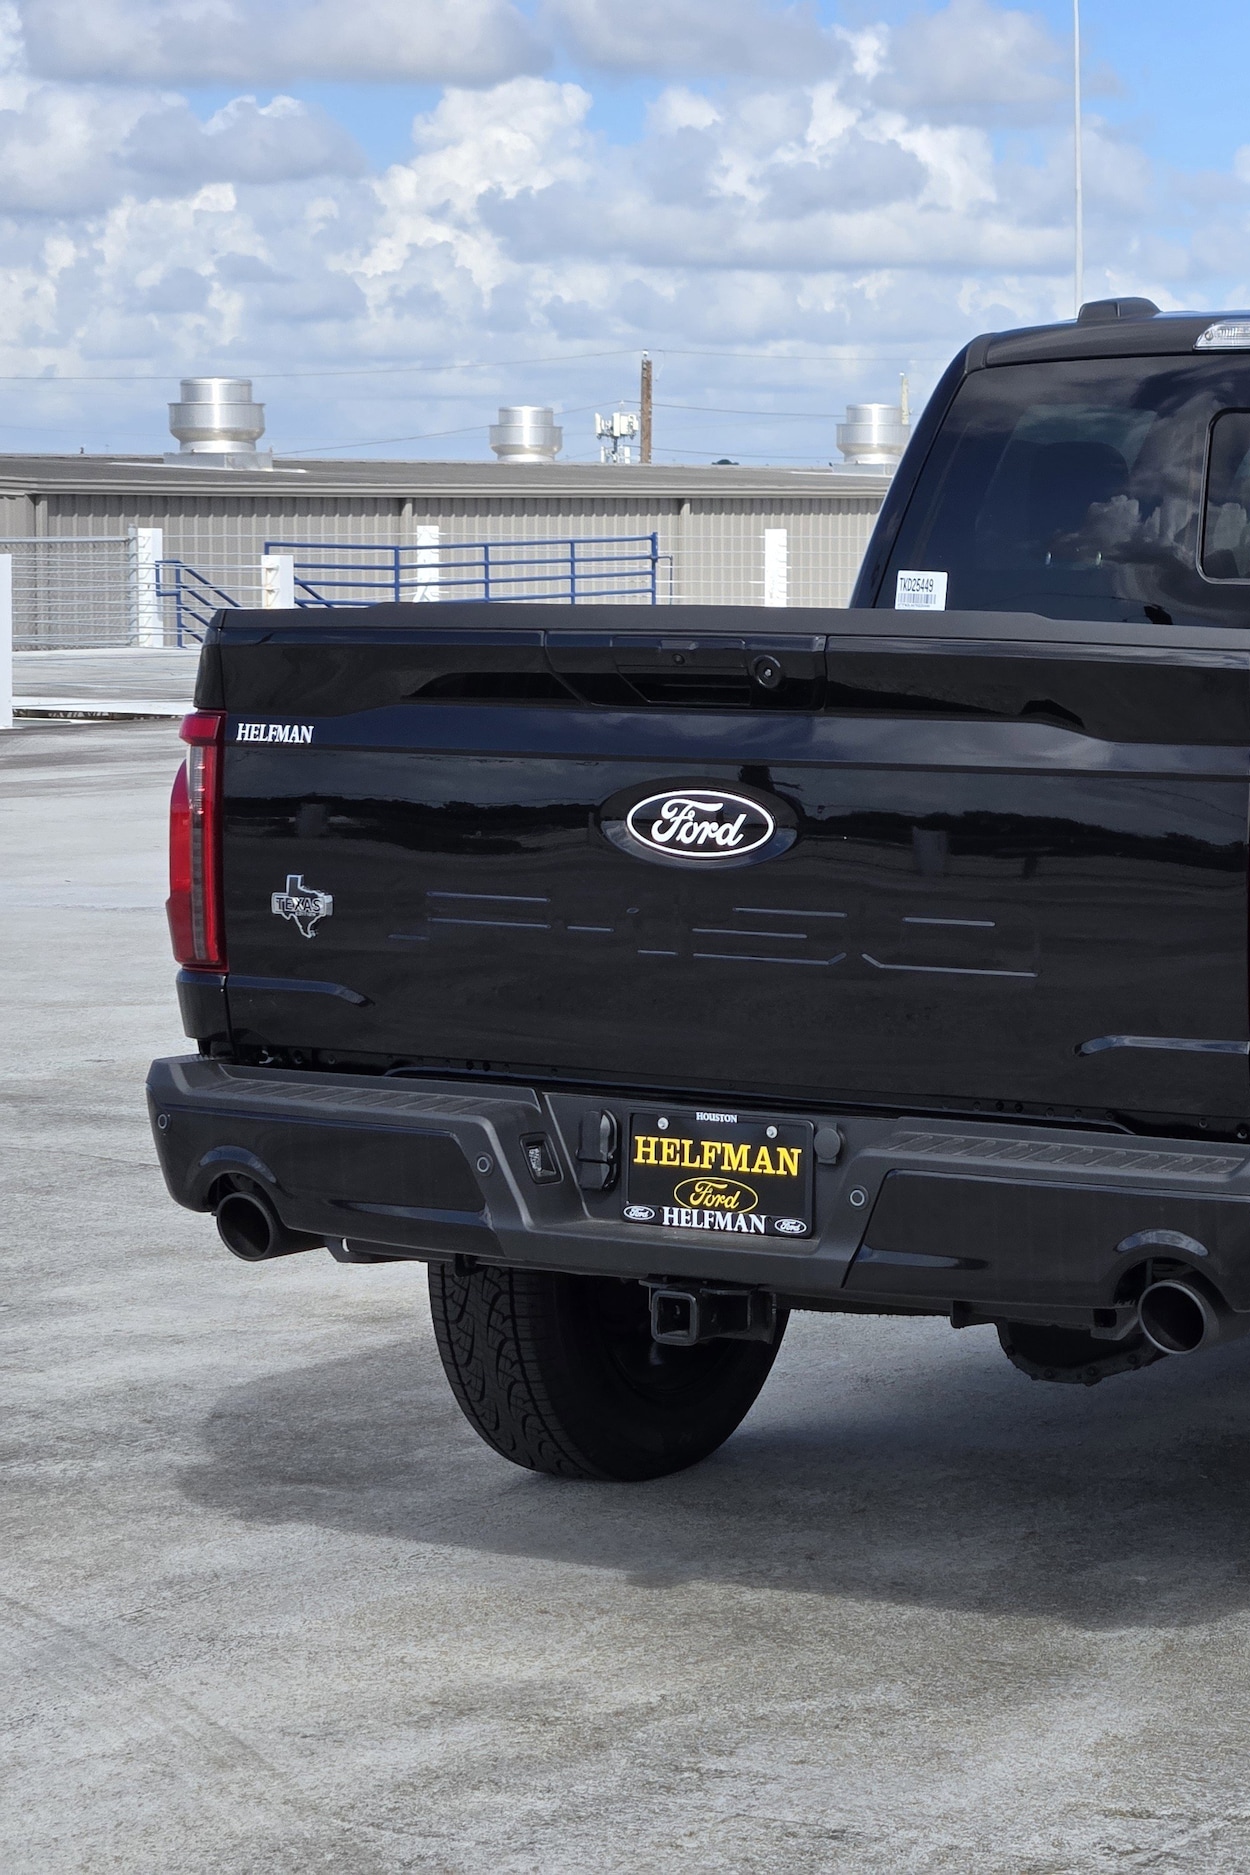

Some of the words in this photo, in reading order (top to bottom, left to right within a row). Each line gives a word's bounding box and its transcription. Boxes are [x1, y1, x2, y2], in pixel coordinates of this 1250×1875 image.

[236, 723, 314, 744] HELFMAN
[651, 799, 747, 846] Ford
[275, 896, 321, 913] TEXAS
[696, 1112, 738, 1123] HOUSTON
[633, 1135, 802, 1177] HELFMAN
[689, 1181, 741, 1210] Ford
[662, 1206, 767, 1234] HELFMAN
